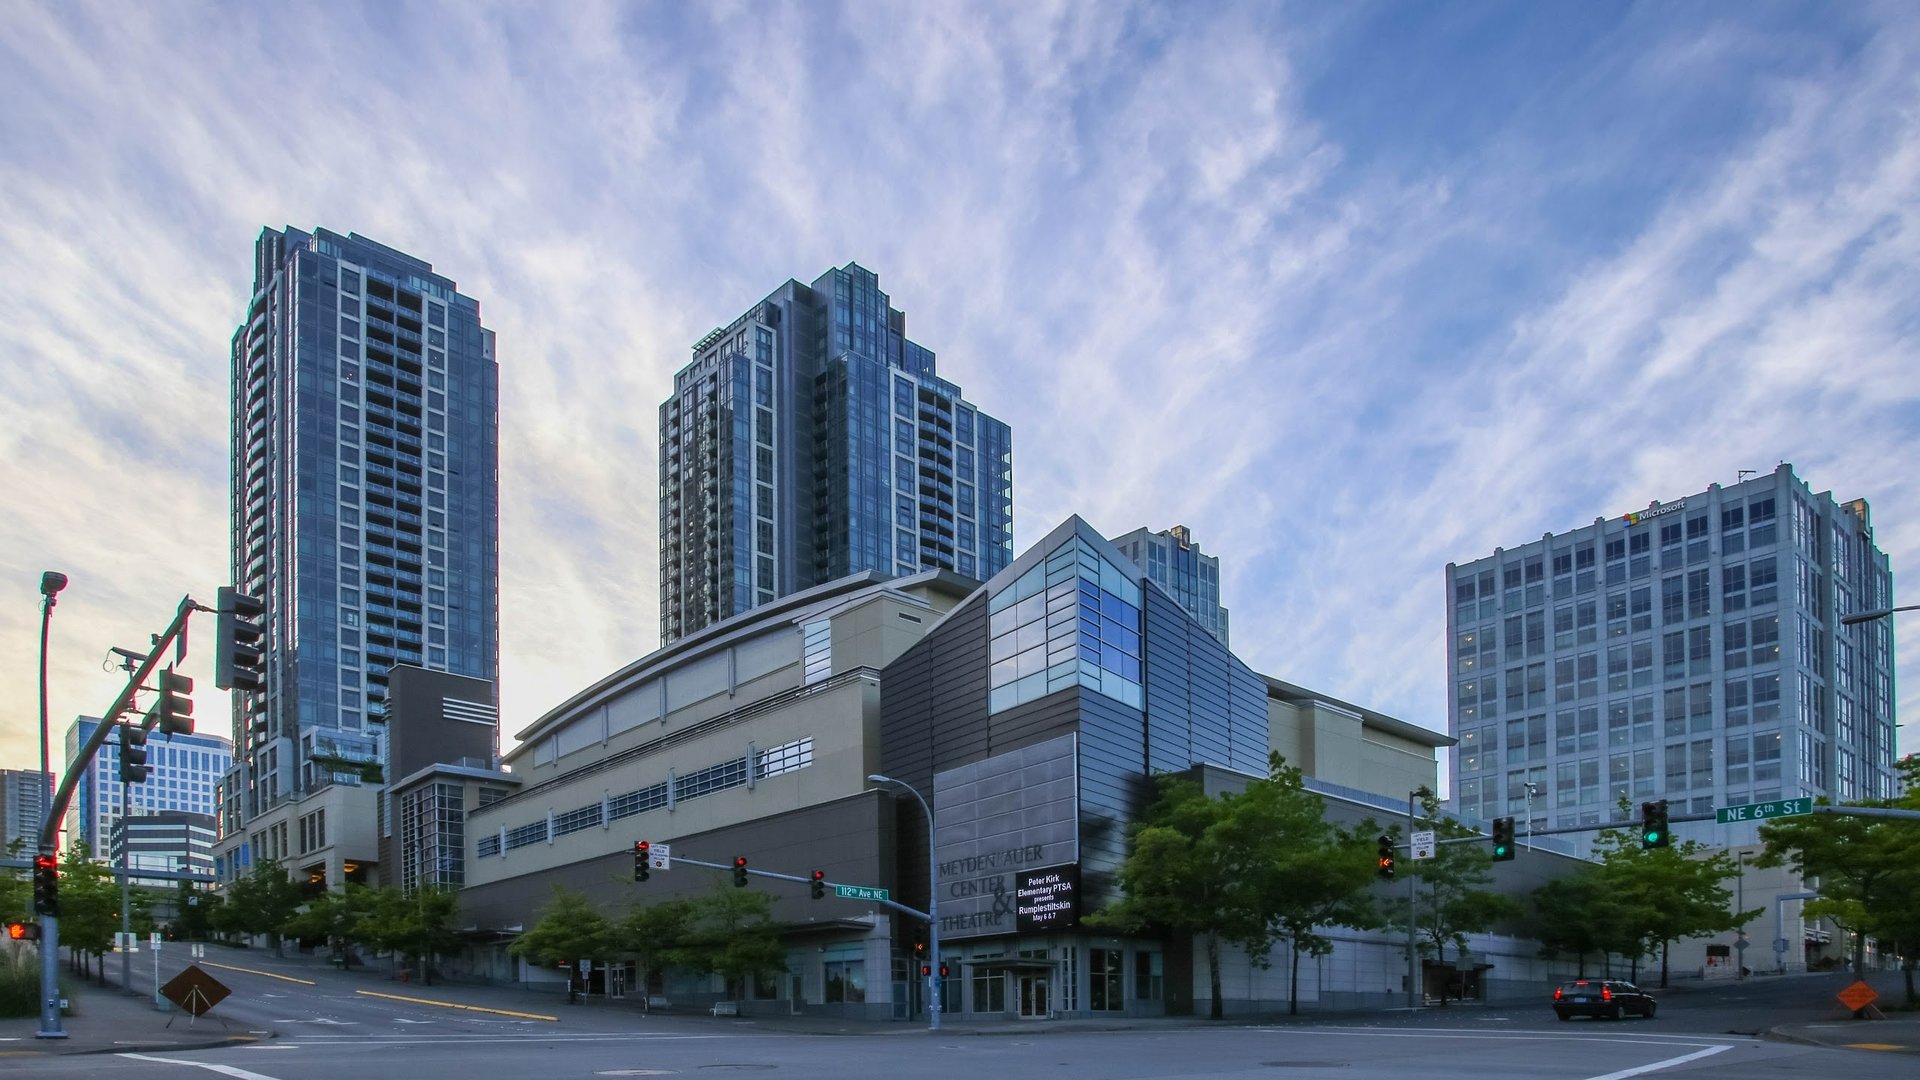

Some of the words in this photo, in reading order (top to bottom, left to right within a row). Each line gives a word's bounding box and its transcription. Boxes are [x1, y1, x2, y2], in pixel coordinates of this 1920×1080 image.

[1639, 500, 1685, 520] Microsoft
[1727, 807, 1746, 821] NE
[1754, 803, 1775, 818] 6th
[1783, 801, 1800, 814] St
[940, 845, 1043, 877] MEYDENAUER
[950, 875, 1005, 898] CENTER
[1028, 877, 1045, 887] Peter
[1045, 874, 1060, 883] Kirk
[841, 886, 857, 896] 112th
[858, 888, 871, 898] Ave
[873, 890, 883, 900] NE
[1017, 886, 1052, 897] Elementary
[1053, 882, 1072, 892] PTSA
[1033, 894, 1054, 904] presents
[1018, 901, 1071, 915] Rumplestiltskin
[939, 911, 1003, 931] THEATRE
